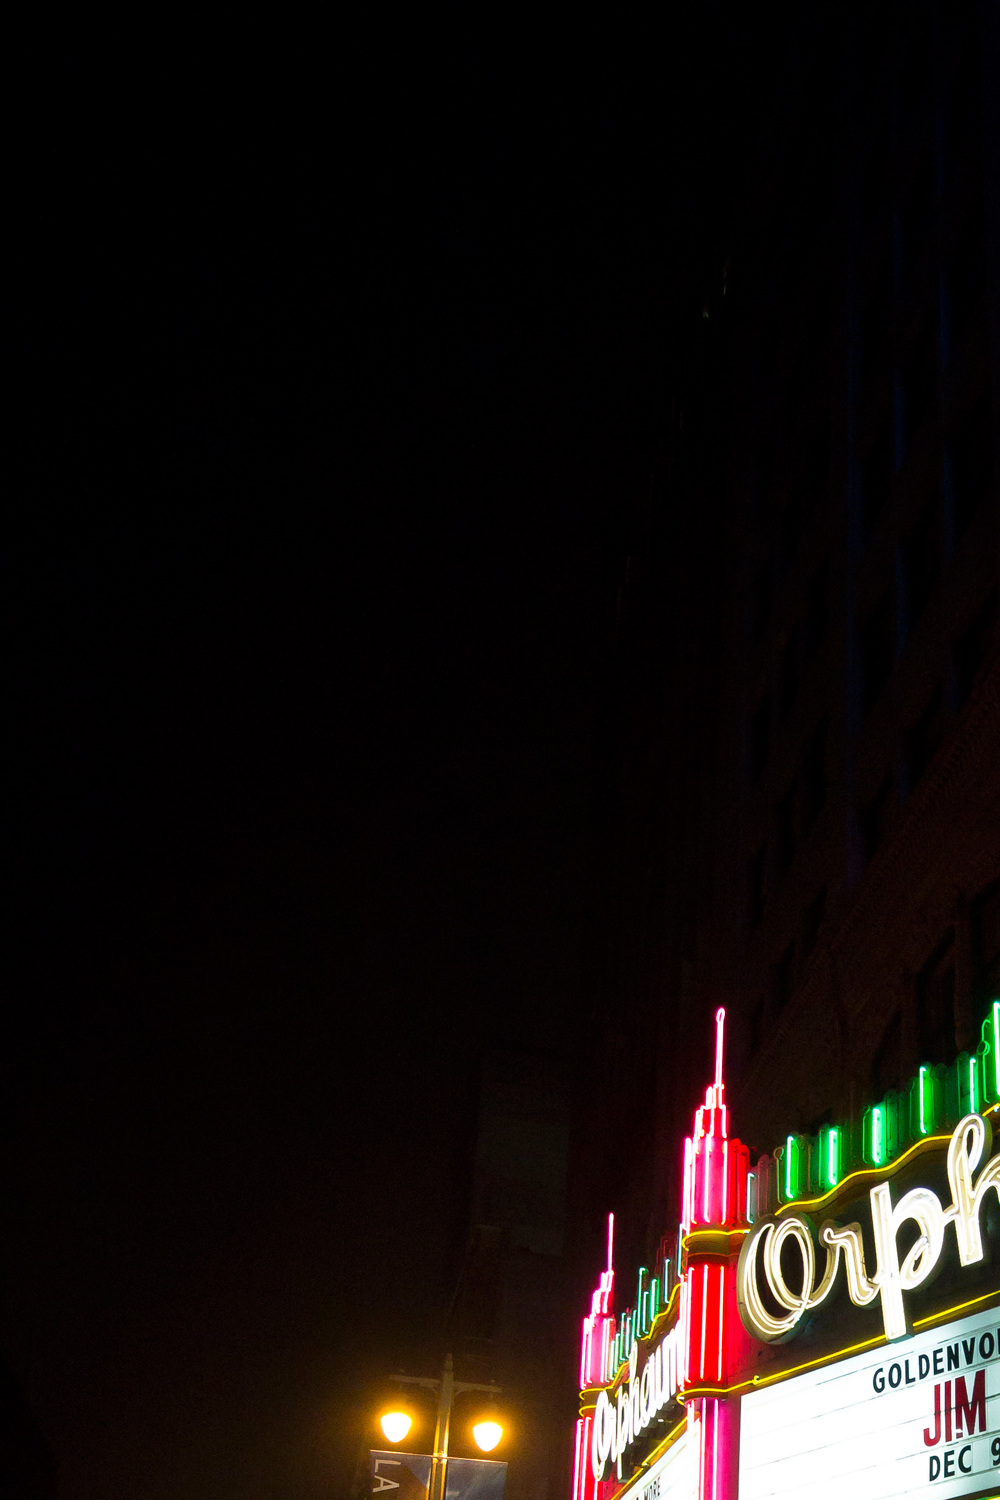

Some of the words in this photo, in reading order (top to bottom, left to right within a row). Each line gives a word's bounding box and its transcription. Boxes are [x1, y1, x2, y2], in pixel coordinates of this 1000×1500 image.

[923, 1368, 987, 1447] JIM
[372, 1459, 401, 1493] LA
[929, 1445, 972, 1482] DEC
